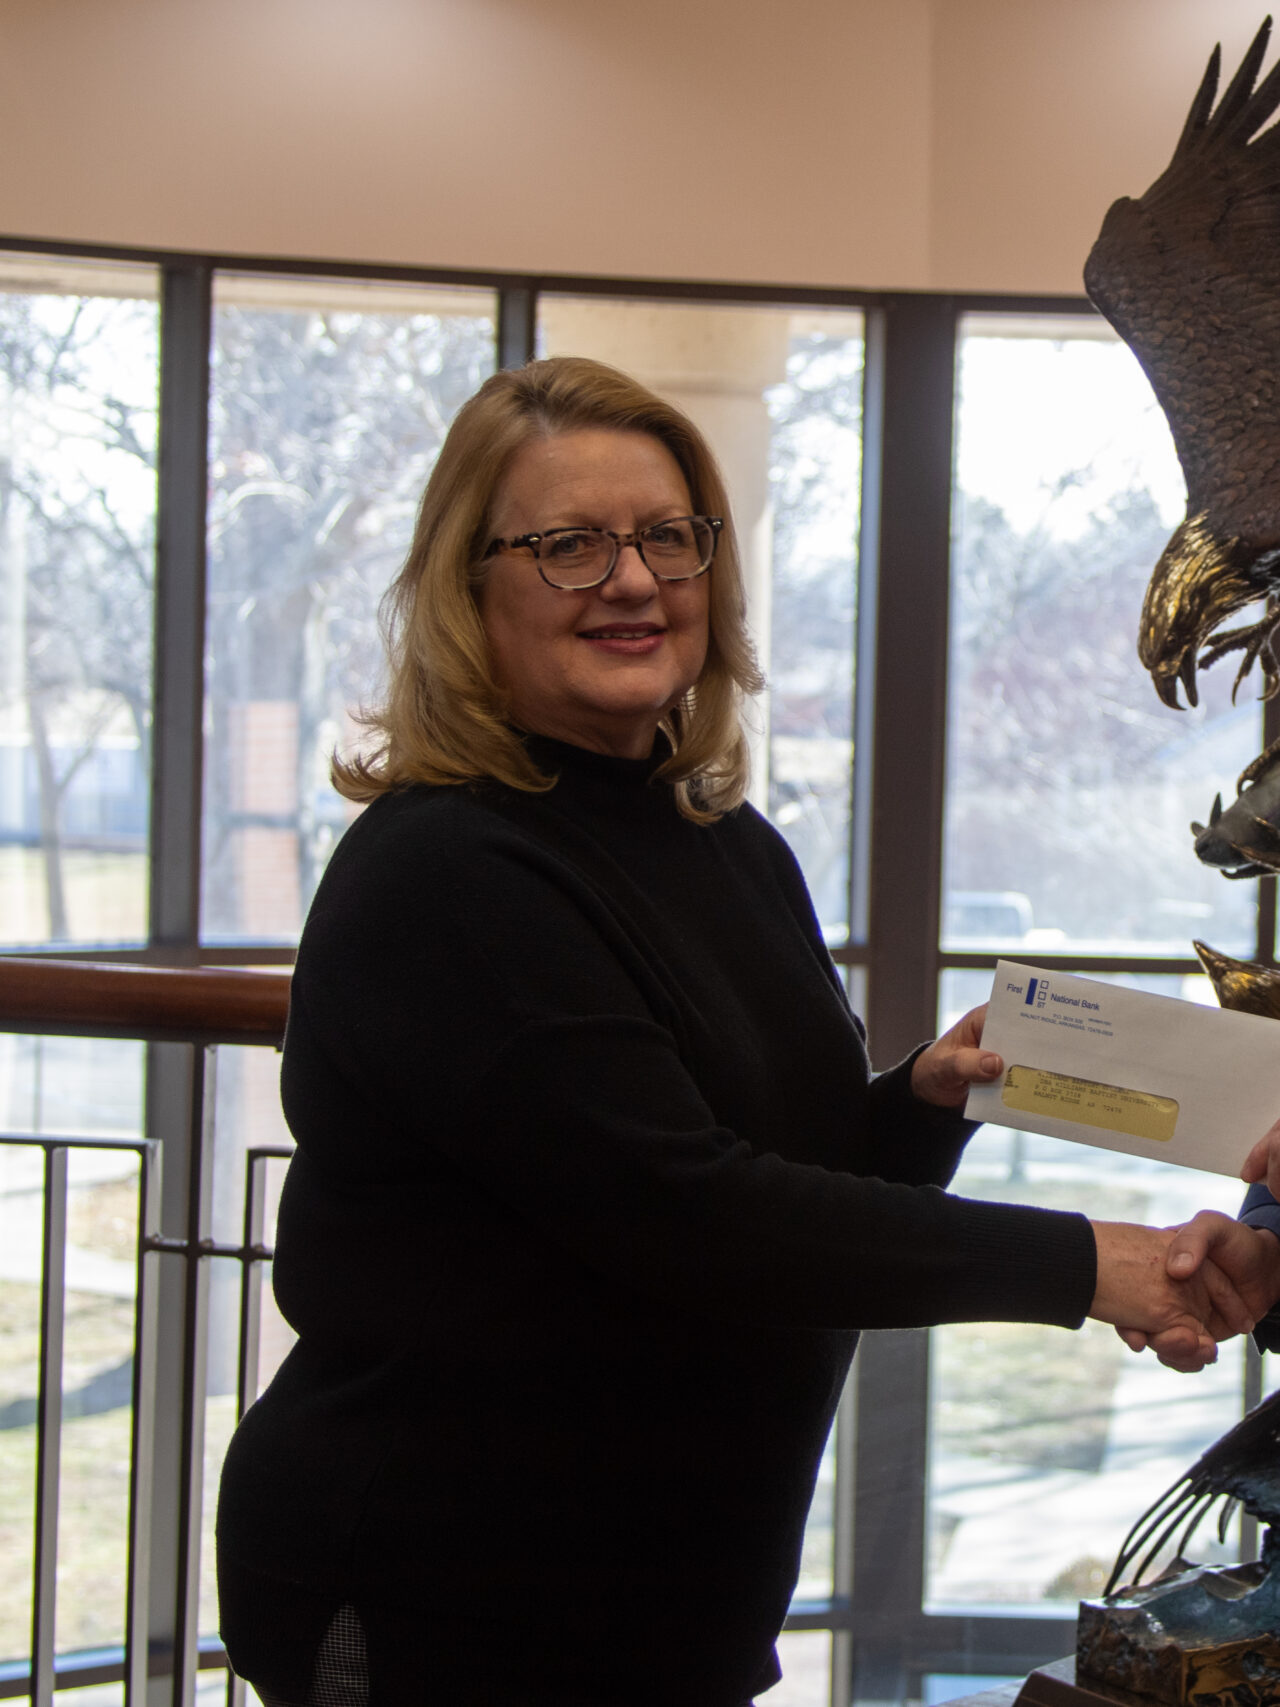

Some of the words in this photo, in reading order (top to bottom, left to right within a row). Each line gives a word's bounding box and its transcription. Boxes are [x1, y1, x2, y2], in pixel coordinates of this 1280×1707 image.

[1006, 983, 1023, 994] First
[1050, 993, 1080, 1007] National
[1081, 1000, 1100, 1011] Bank
[1020, 1012, 1040, 1021] WALNUT
[1033, 1091, 1057, 1102] WALNUT
[1055, 1081, 1087, 1093] WILLIAMS
[1089, 1088, 1117, 1100] BAPTIST
